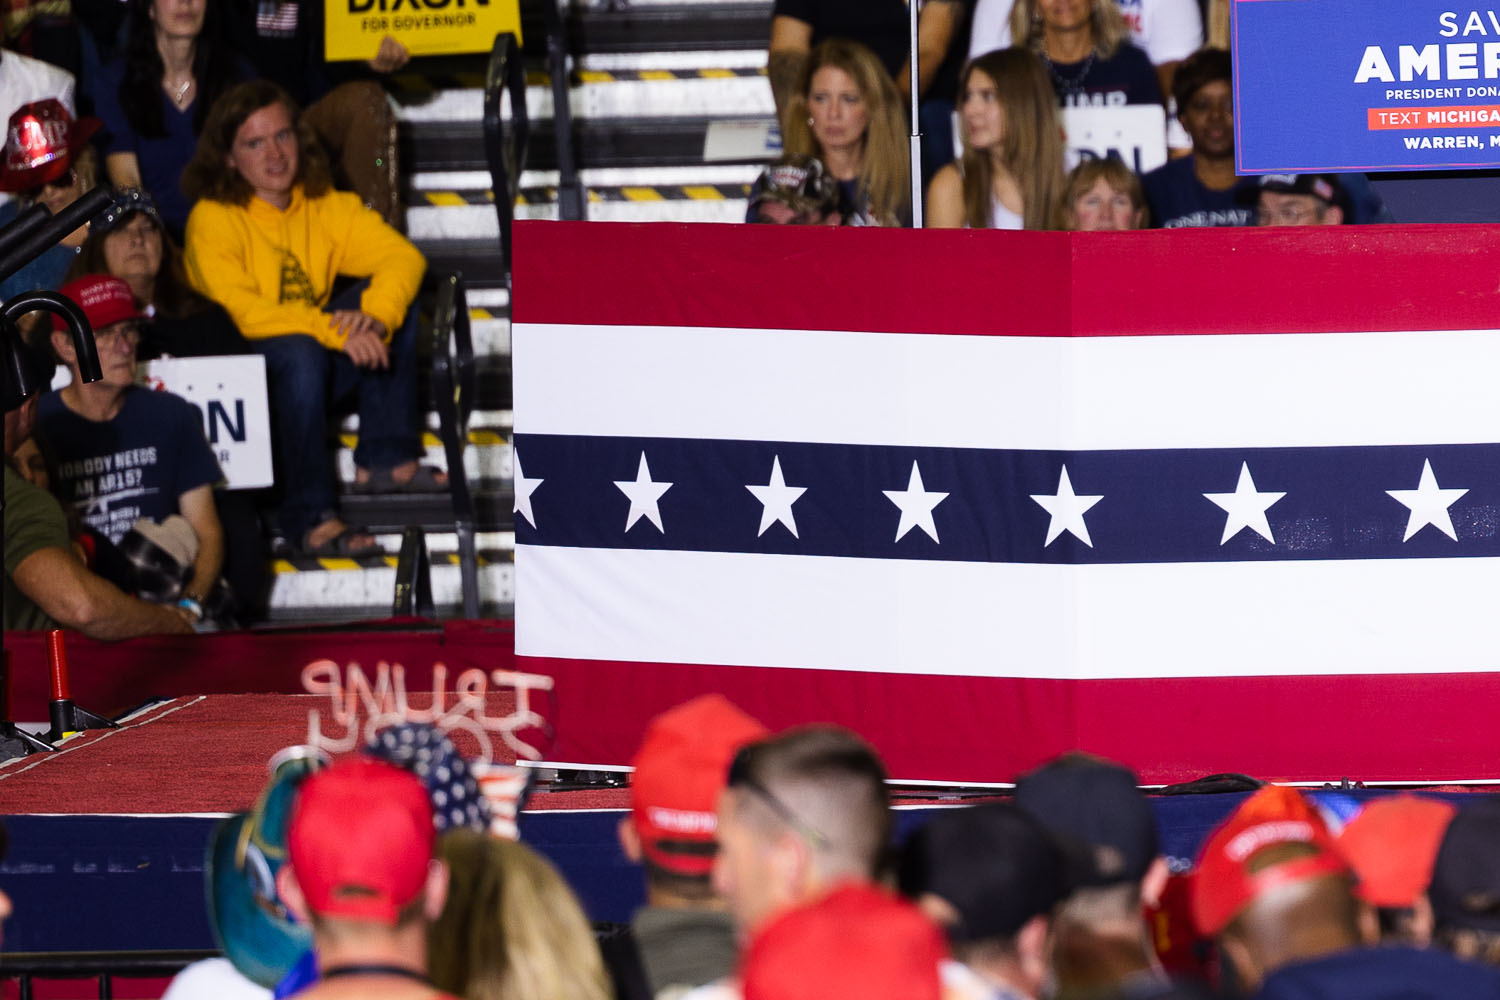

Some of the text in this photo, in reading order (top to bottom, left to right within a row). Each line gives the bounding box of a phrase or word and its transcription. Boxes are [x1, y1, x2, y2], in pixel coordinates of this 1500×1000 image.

[362, 13, 476, 31] FOR GOVERNOR
[1386, 87, 1462, 100] PRESIDENT
[1379, 112, 1421, 125] TEXT
[1403, 135, 1485, 150] WARREN,
[114, 446, 157, 470] NEEDS
[76, 468, 143, 496] AN AR15?
